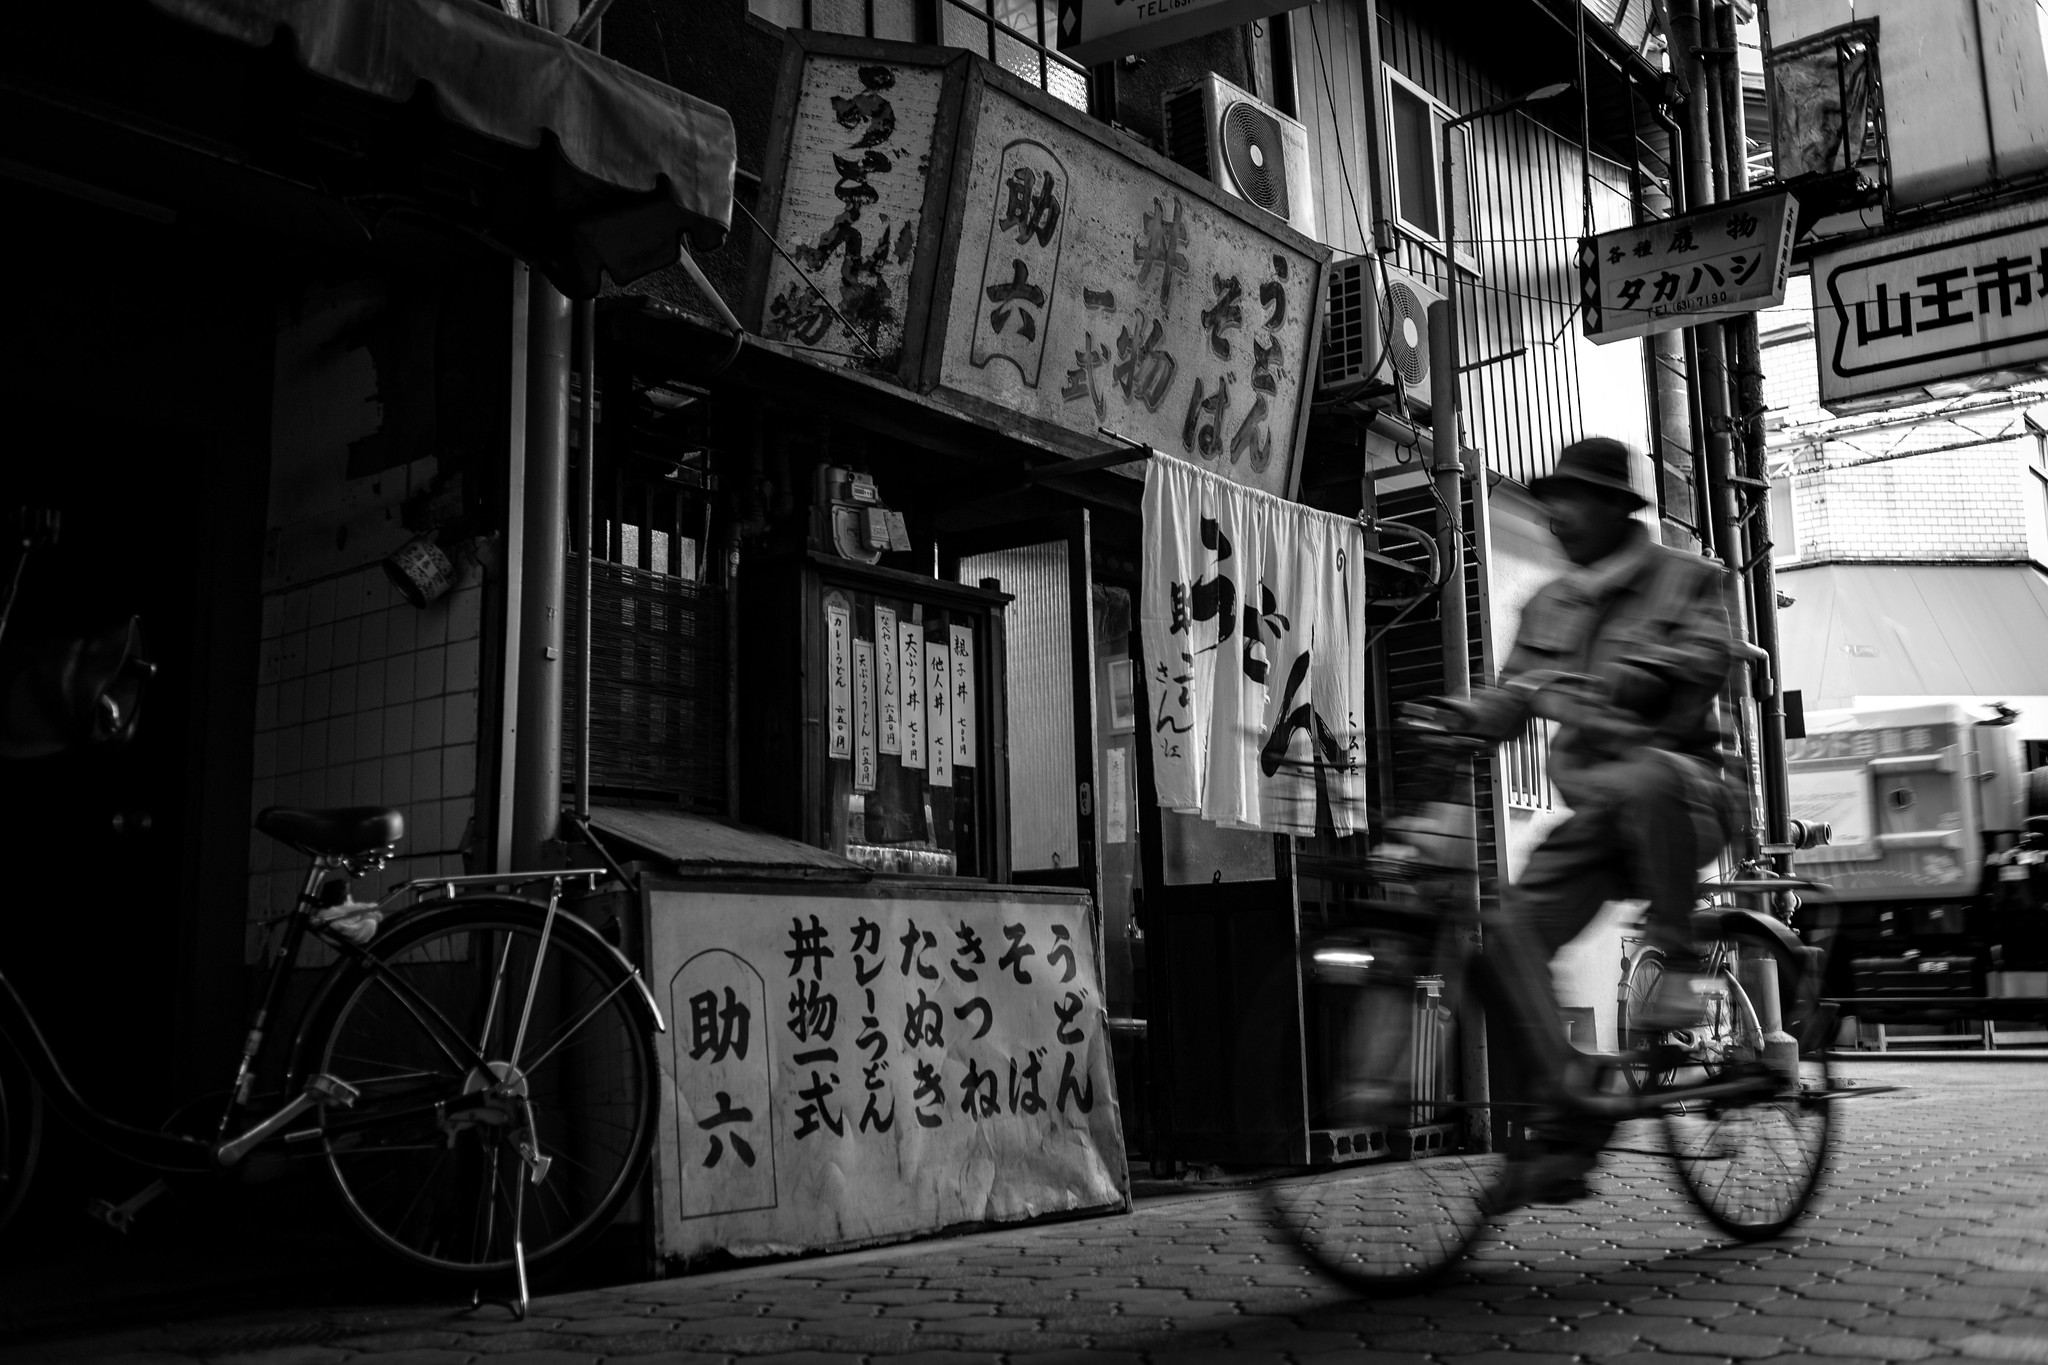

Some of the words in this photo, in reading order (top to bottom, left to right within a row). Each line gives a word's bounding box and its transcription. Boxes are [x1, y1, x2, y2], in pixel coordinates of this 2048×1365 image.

[986, 167, 1062, 343] 助六
[1618, 253, 1761, 309] タカハシ
[1061, 285, 1115, 418] 一式
[1183, 271, 1241, 460] そば
[1230, 253, 1296, 473] うどん
[834, 617, 846, 688] カレーうどん
[858, 653, 870, 737] 天ぷらうどん
[688, 986, 756, 1169] 助六
[783, 914, 844, 1140] 丼物一式
[849, 916, 895, 1135] カレーうどん
[900, 918, 946, 1128] たぬき
[950, 920, 999, 1122] きつね
[998, 922, 1049, 1117] そば
[1046, 923, 1093, 1115] うどん
